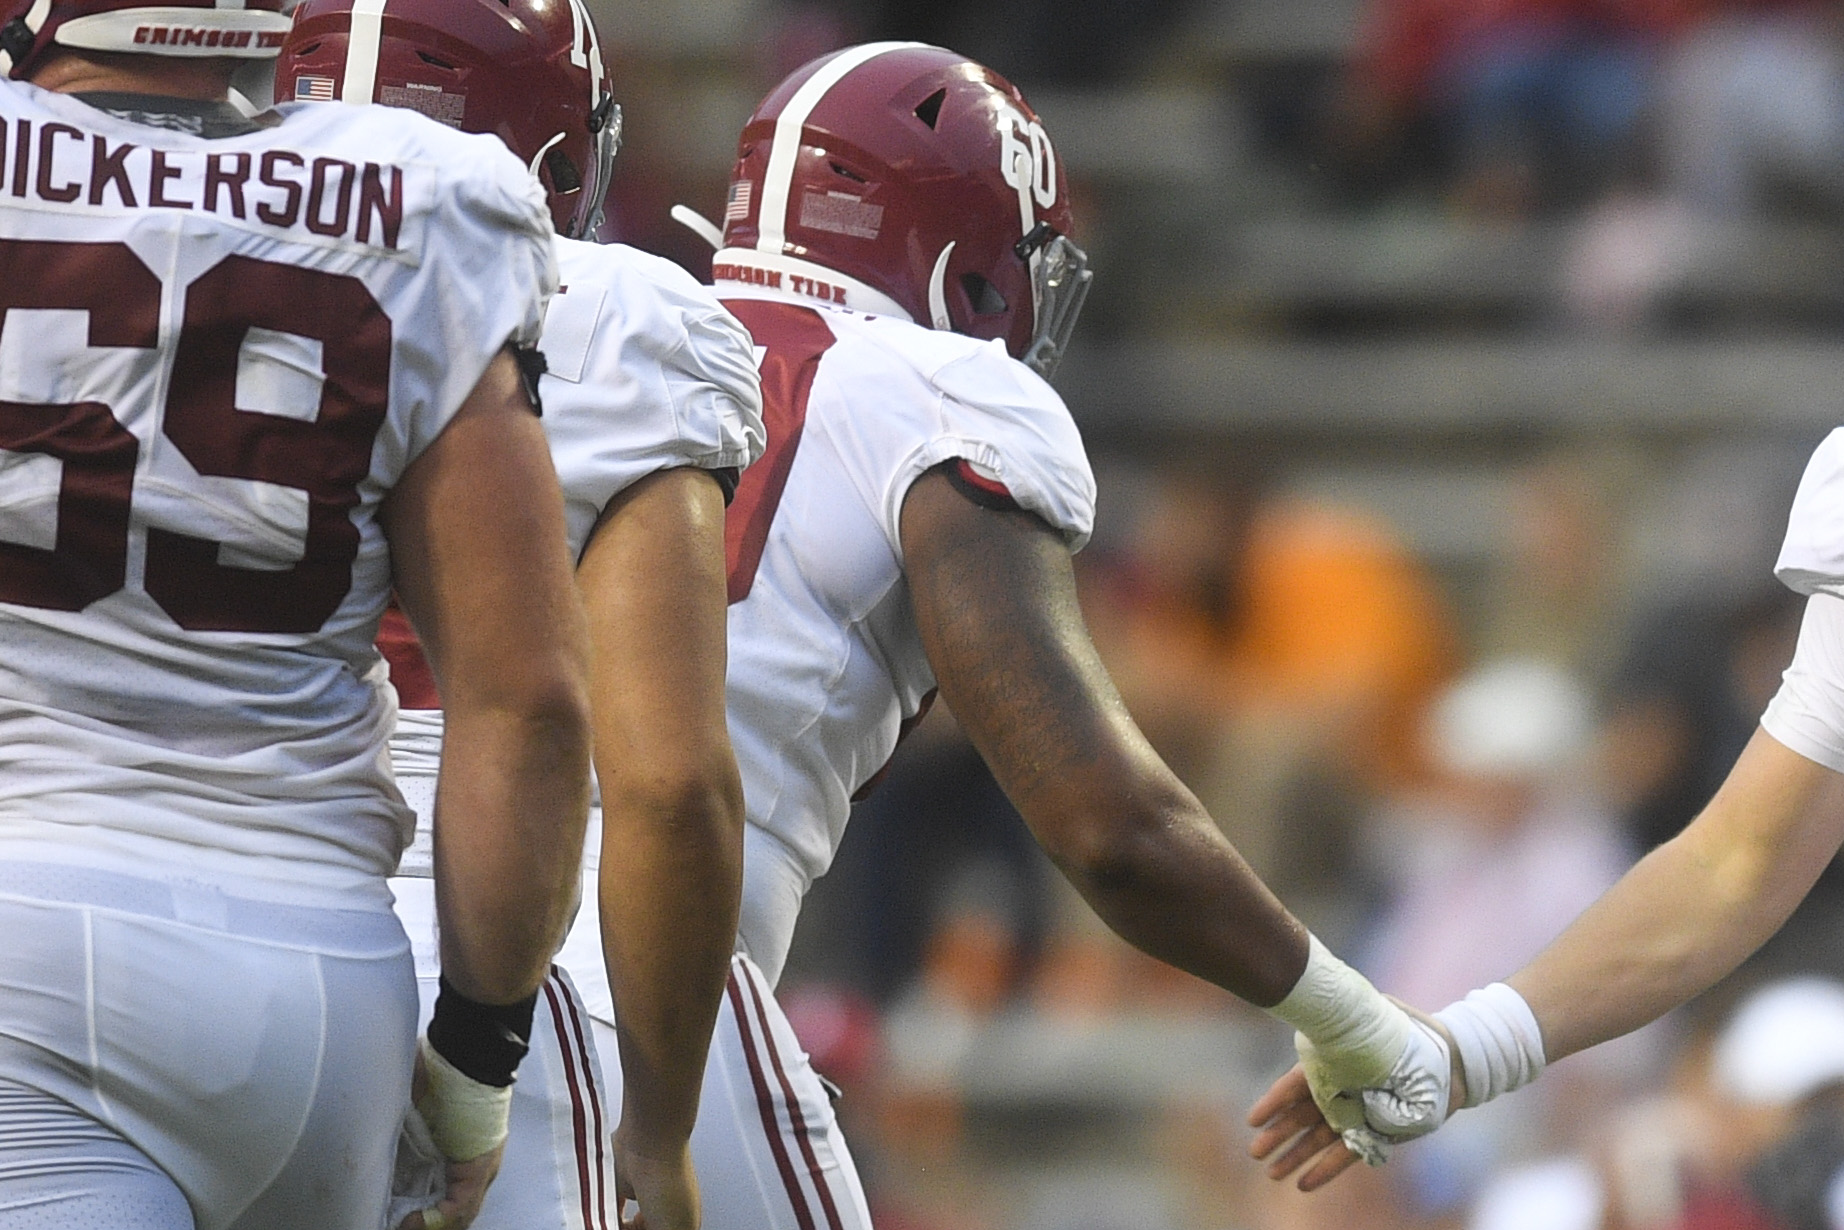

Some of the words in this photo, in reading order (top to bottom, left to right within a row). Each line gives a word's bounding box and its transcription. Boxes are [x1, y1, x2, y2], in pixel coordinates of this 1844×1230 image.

[0, 115, 403, 250] ICKERSON
[996, 103, 1057, 210] 60
[789, 273, 847, 306] TIDE
[0, 238, 394, 634] 69
